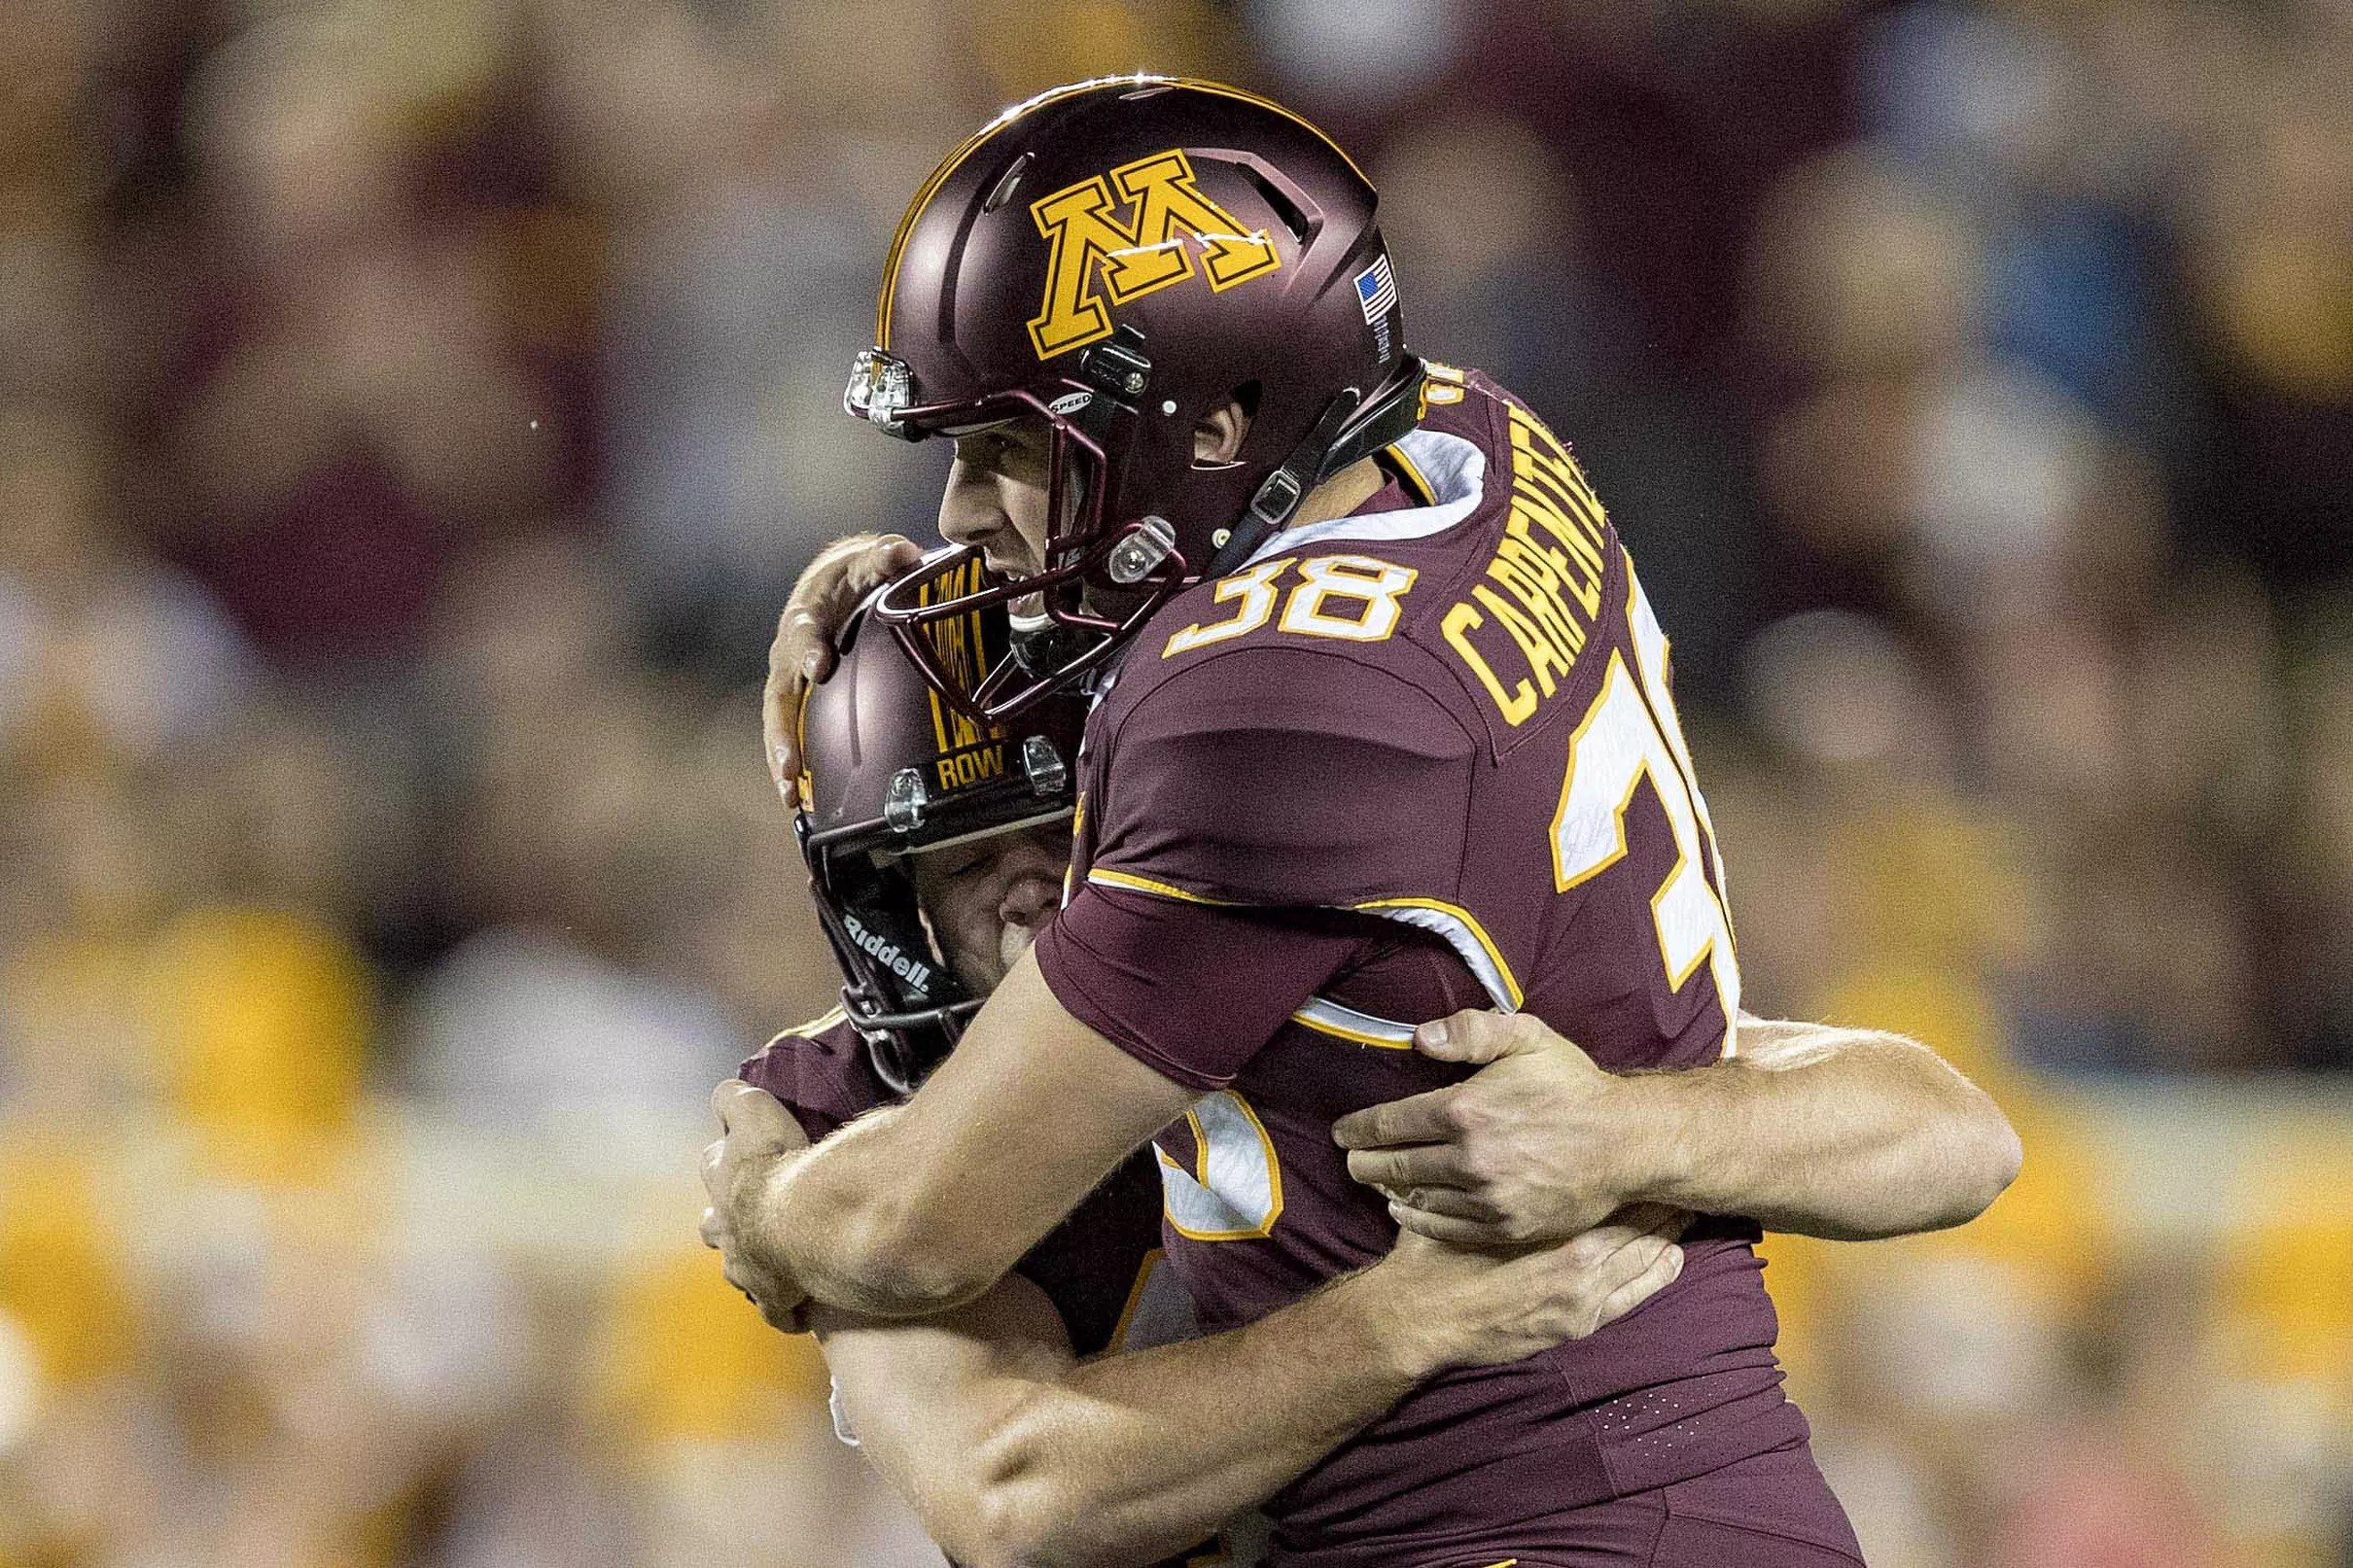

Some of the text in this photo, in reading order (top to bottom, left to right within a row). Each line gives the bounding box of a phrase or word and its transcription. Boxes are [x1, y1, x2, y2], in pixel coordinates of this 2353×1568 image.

[1026, 148, 1281, 361] M
[1051, 394, 1091, 413] SPEED
[1161, 554, 1420, 659] 38
[936, 745, 1003, 790] ROW
[843, 914, 931, 990] Riddell
